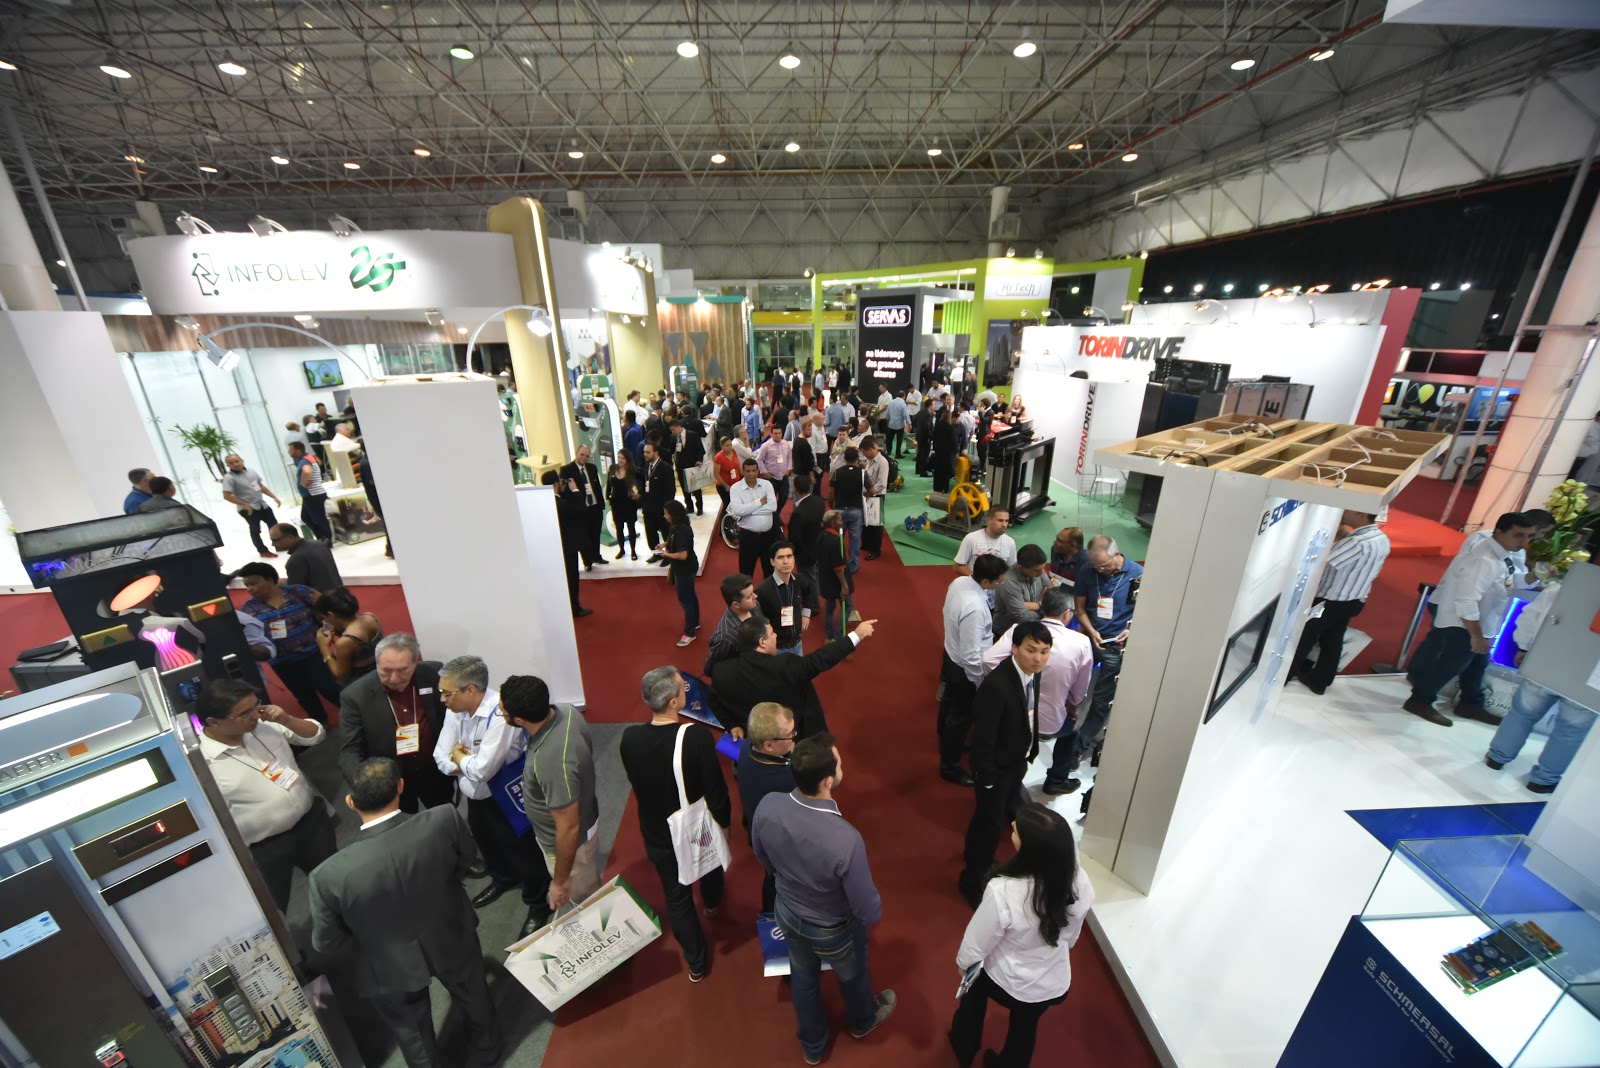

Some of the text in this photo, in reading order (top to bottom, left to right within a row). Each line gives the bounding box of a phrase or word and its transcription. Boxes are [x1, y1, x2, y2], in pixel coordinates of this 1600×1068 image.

[226, 262, 328, 283] INFOLEV
[1002, 282, 1036, 296] Hi Tech
[867, 308, 907, 324] SERVAS
[1078, 334, 1186, 361] TORINDRIVE
[1075, 384, 1097, 476] TORINDRIVE
[576, 930, 621, 965] INFOLEV
[1375, 979, 1401, 1008] solutions
[1401, 1006, 1411, 1017] for
[1410, 1017, 1425, 1033] your
[1424, 1032, 1452, 1063] industry
[1379, 970, 1455, 1059] SCHMERSAL
